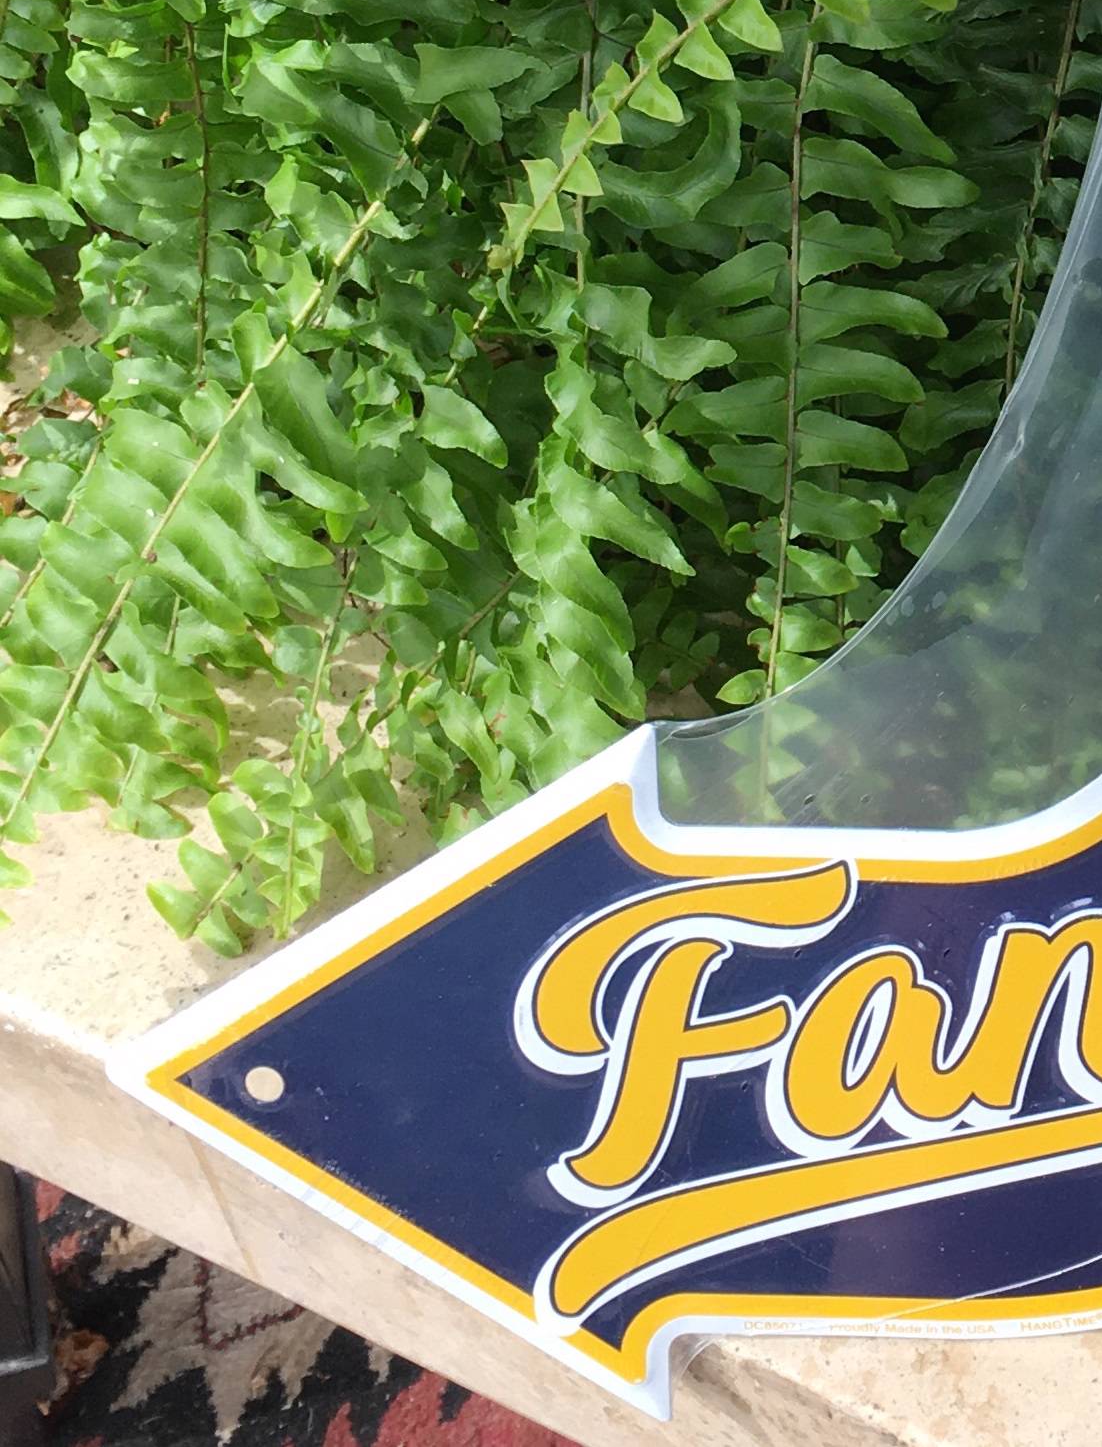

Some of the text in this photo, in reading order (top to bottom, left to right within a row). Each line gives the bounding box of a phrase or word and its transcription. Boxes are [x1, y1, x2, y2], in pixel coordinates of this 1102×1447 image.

[884, 1323, 922, 1334] Made
[925, 1324, 938, 1334] in
[941, 1324, 963, 1335] the
[966, 1324, 997, 1335] USA
